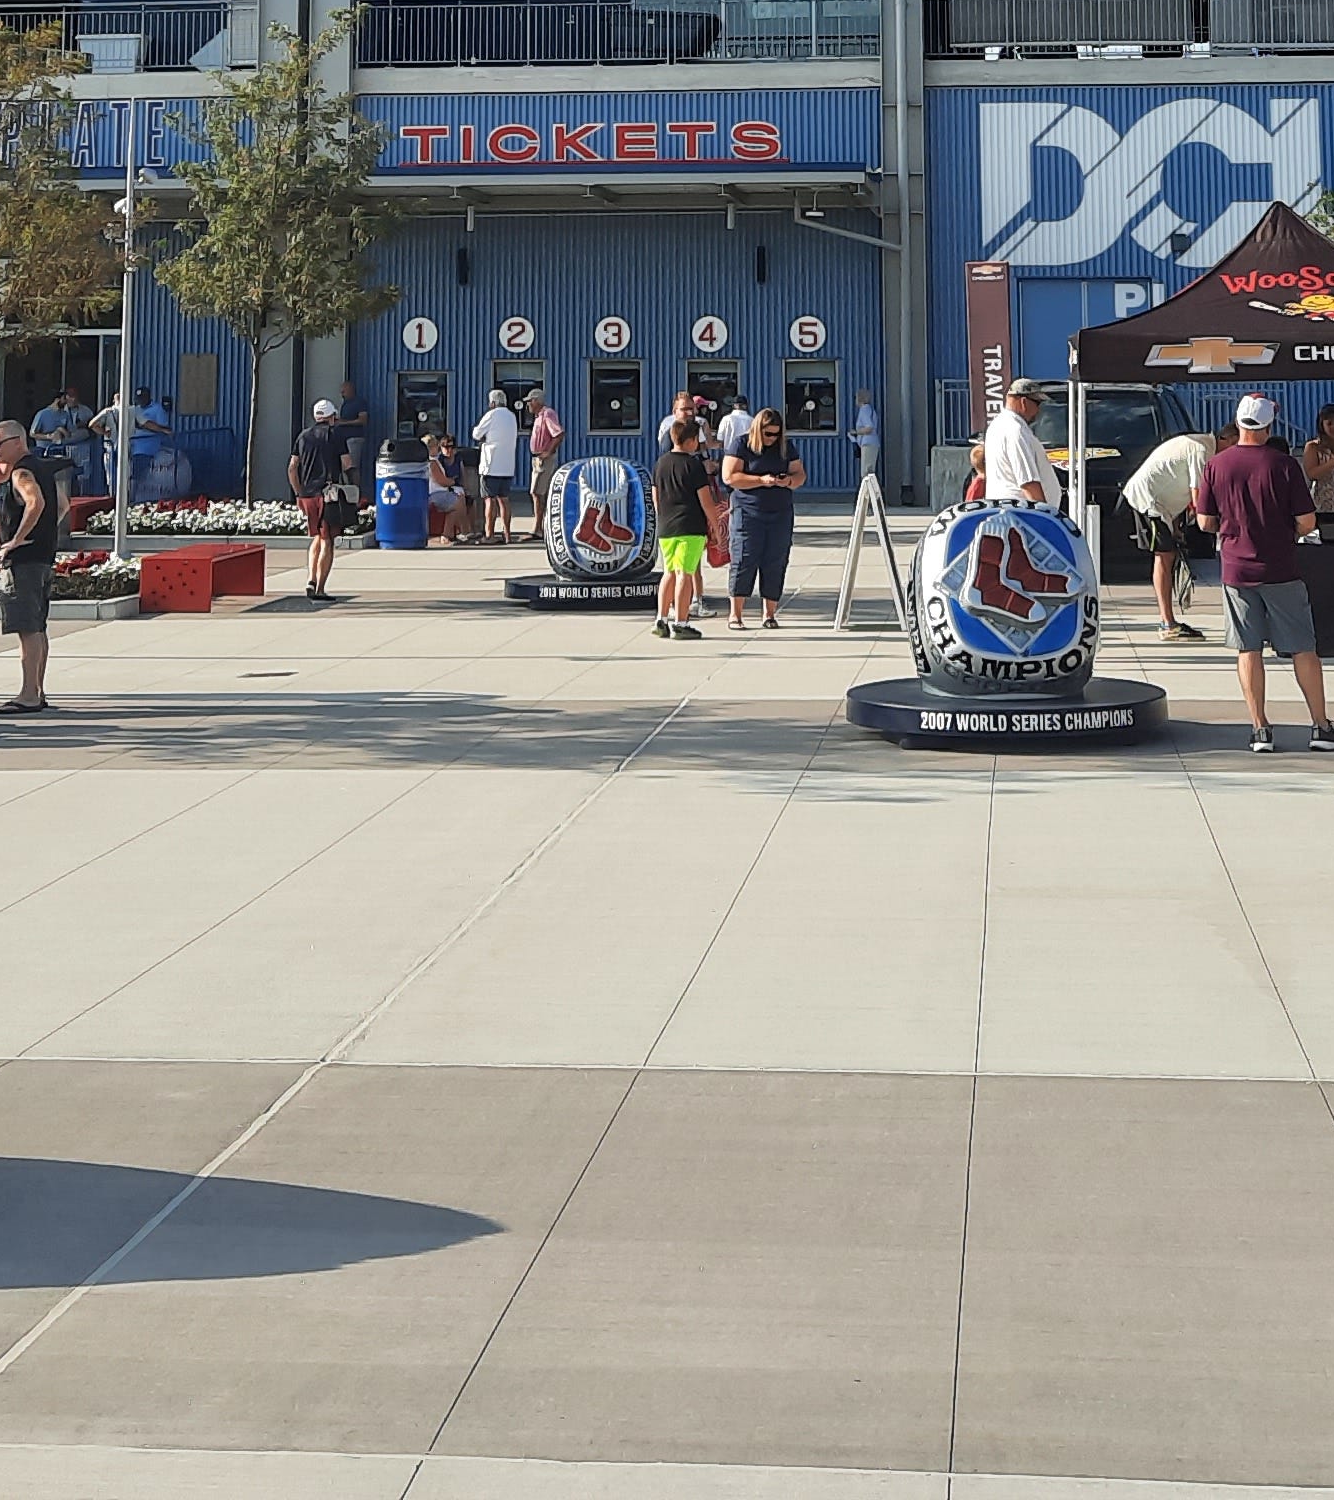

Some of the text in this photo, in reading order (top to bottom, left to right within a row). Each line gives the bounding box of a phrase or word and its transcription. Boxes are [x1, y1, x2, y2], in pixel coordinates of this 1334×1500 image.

[399, 120, 782, 164] TICKETS
[414, 323, 426, 349] 1
[506, 322, 527, 348] 2
[603, 322, 623, 348] 3
[698, 321, 718, 348] 4
[798, 321, 818, 348] 5
[982, 344, 1005, 424] TRAVE
[538, 584, 659, 599] 2013 WORLD SERIES CHAMPI
[926, 595, 1099, 681] CHAMPIONS
[919, 709, 1135, 732] 2007 WORLD SERIES CHAMPIONS
